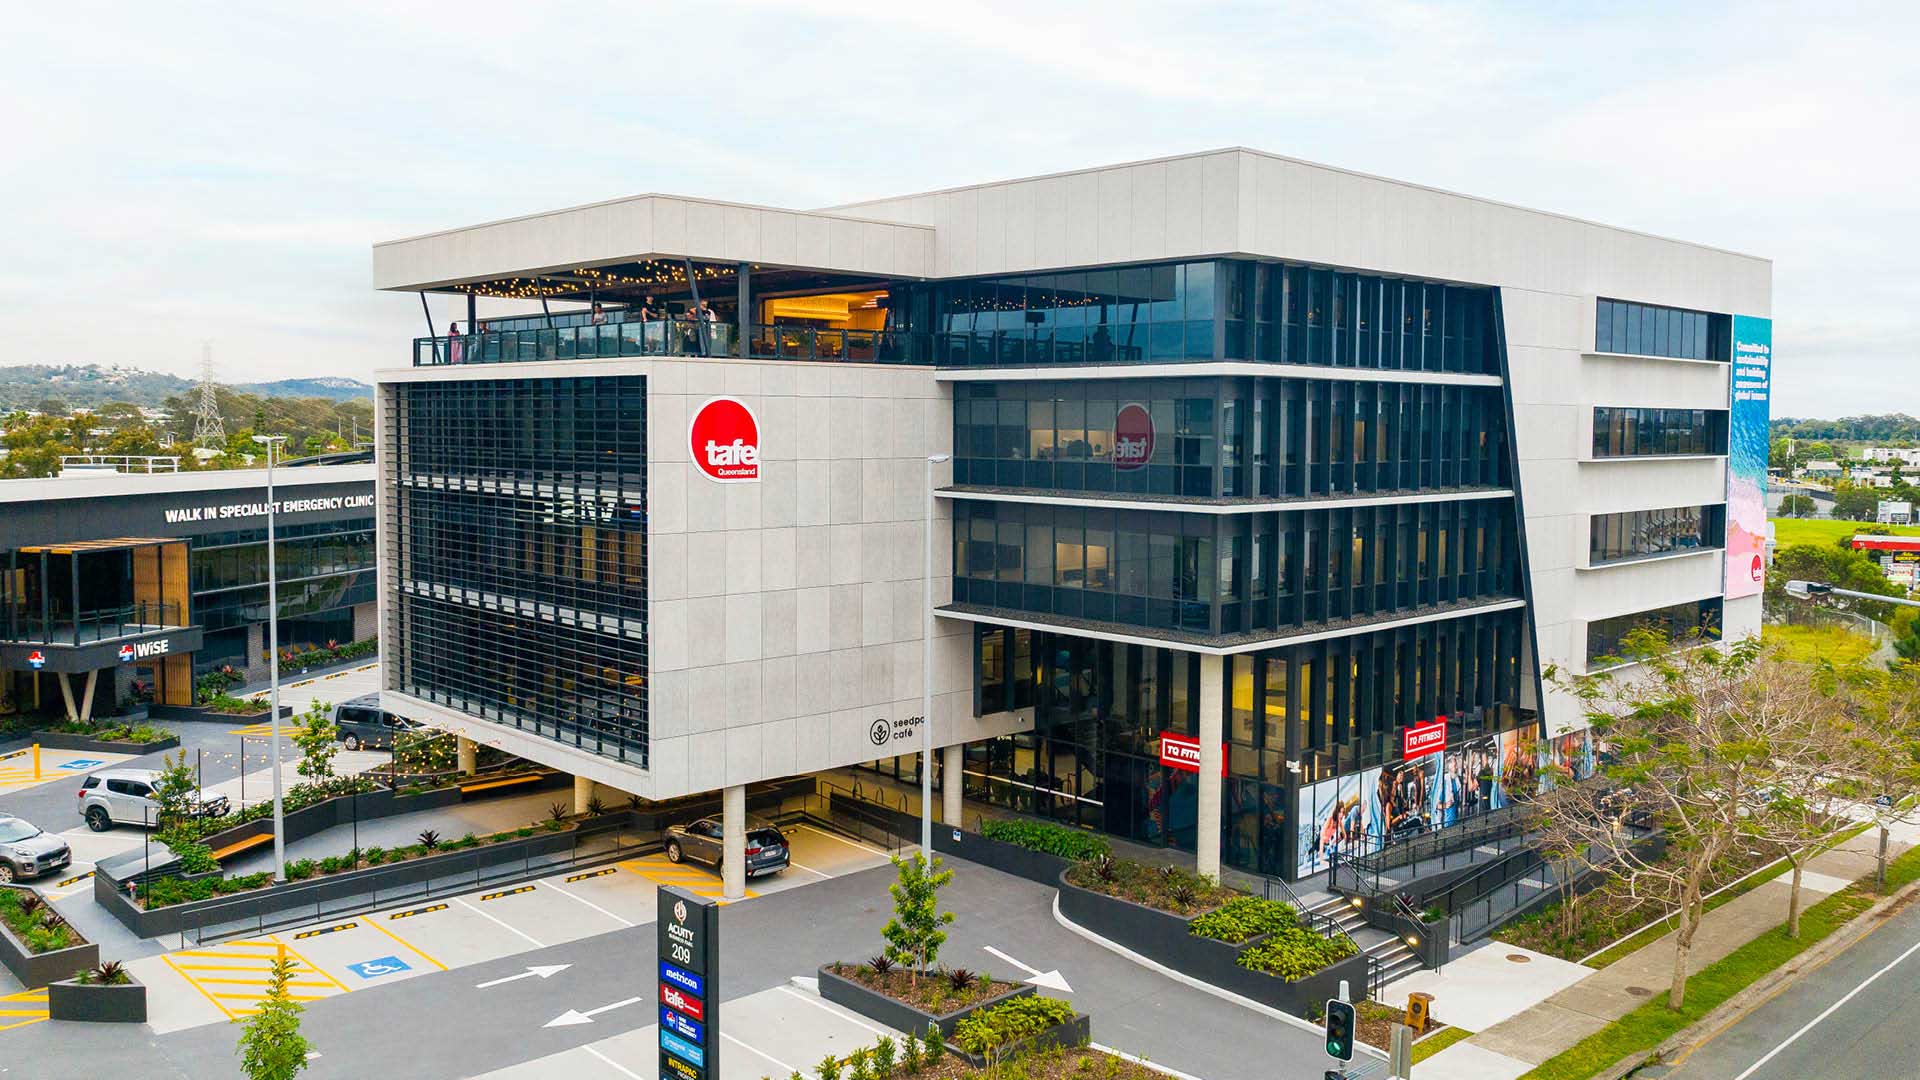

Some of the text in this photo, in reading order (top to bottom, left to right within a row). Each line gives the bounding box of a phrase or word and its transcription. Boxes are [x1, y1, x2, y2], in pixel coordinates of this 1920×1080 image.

[705, 438, 760, 466] tafe
[718, 468, 756, 476] Queensland
[165, 494, 374, 523] WALK IN SPECIALIST EMERGENCY CLINIC
[893, 716, 924, 727] seedpo
[893, 728, 913, 739] café
[1167, 745, 1201, 760] TQ FITN
[668, 922, 694, 941] ACUITY
[672, 943, 691, 964] 209
[666, 969, 698, 990] metricon
